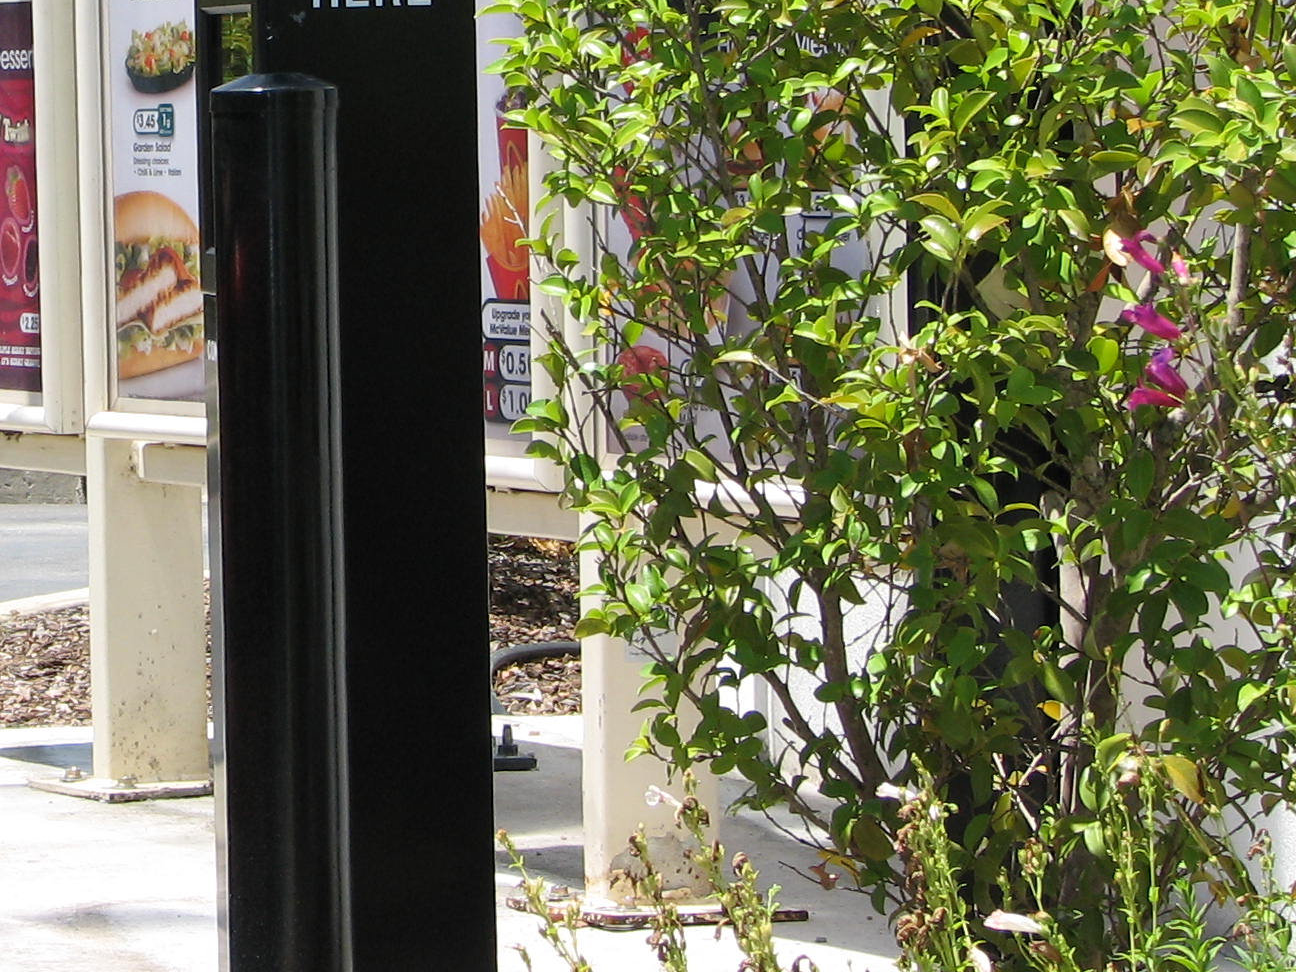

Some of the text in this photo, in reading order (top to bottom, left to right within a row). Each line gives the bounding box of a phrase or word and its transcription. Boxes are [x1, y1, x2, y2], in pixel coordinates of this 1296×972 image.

[133, 142, 171, 152] Garden Salad
[491, 307, 520, 324] Upgrade
[490, 324, 518, 335] McValue
[483, 350, 495, 372] M
[486, 389, 493, 411] L
